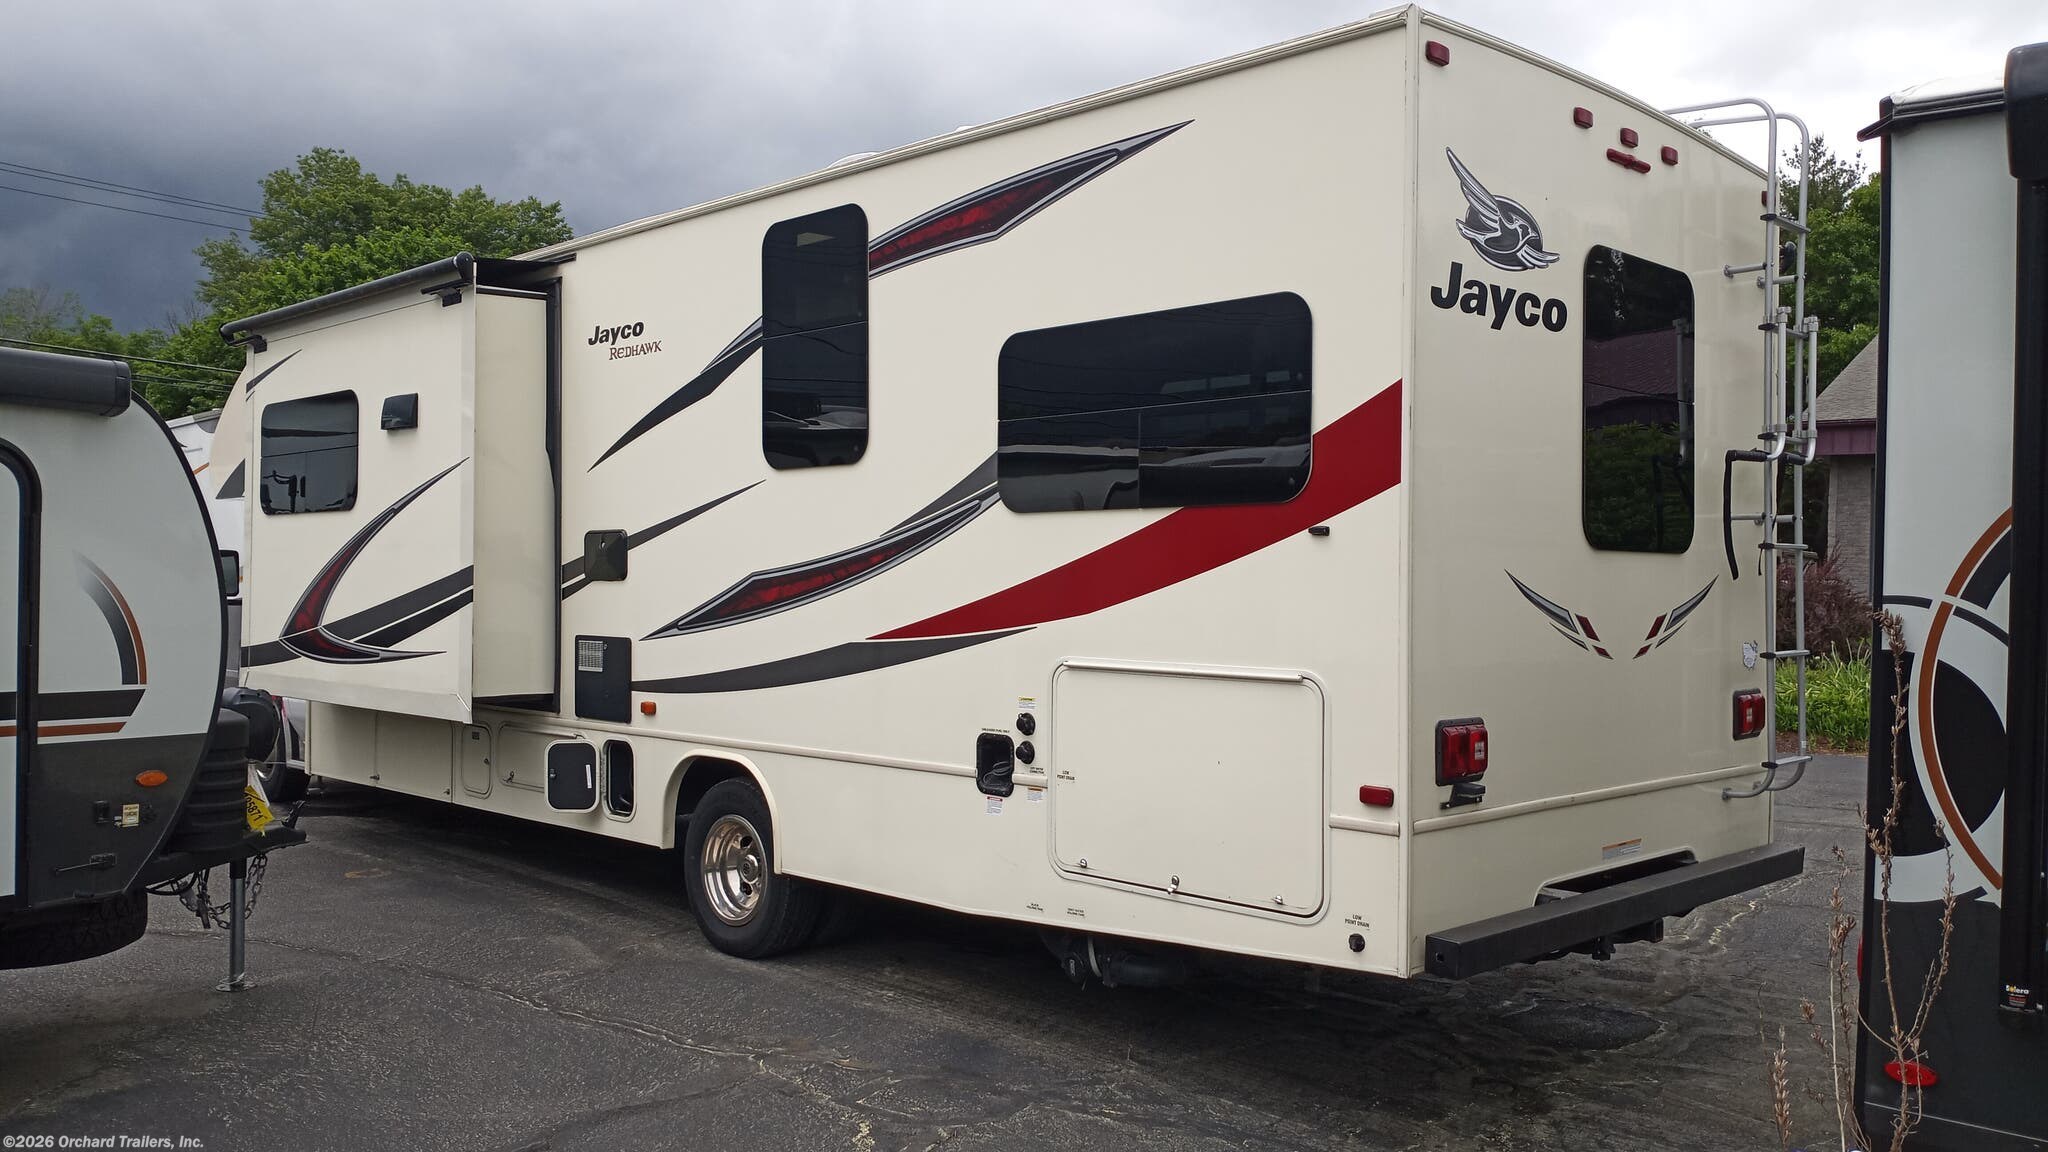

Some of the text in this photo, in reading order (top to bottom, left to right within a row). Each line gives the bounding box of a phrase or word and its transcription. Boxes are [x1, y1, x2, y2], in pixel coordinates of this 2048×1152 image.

[1430, 261, 1568, 332] Jayco
[588, 321, 645, 346] Jayco
[609, 340, 662, 360] REDHAWK
